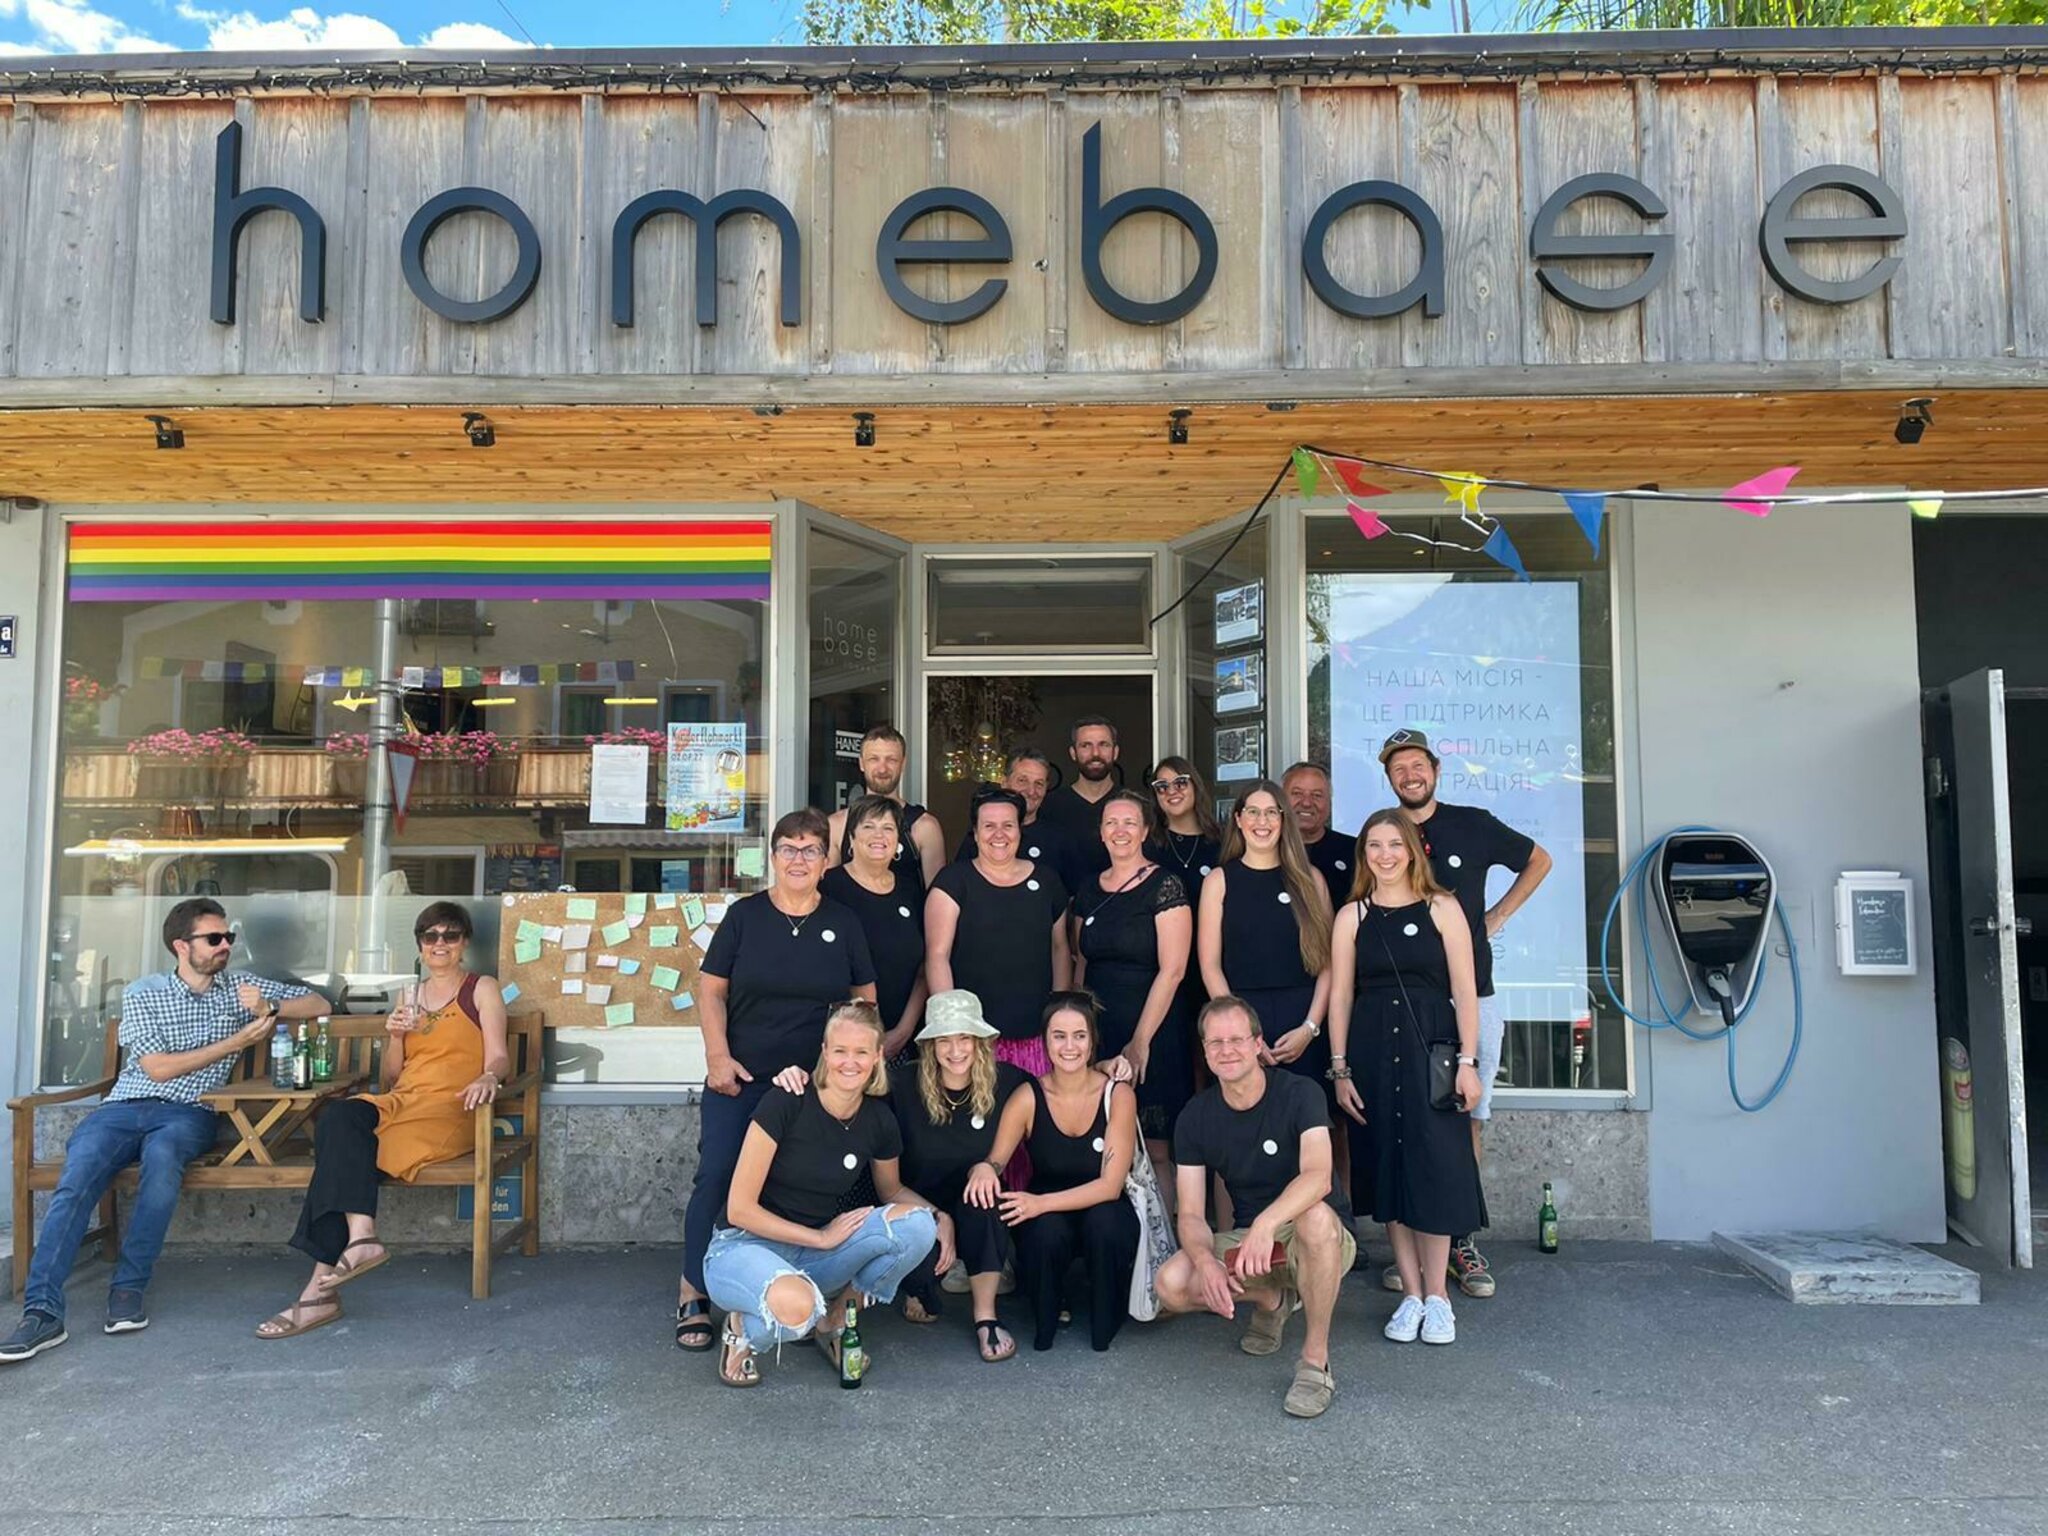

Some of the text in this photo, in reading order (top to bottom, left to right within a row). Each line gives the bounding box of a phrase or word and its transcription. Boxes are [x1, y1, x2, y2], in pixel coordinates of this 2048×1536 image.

[210, 119, 1908, 327] homebase
[823, 611, 878, 644] home
[1367, 669, 1444, 687] НАША
[1455, 668, 1523, 687] МІСІЯ
[1362, 703, 1550, 724] ЦЕ ПІДТРИМКА
[1434, 738, 1550, 756] СПІЛЬНА
[491, 1201, 509, 1212] den
